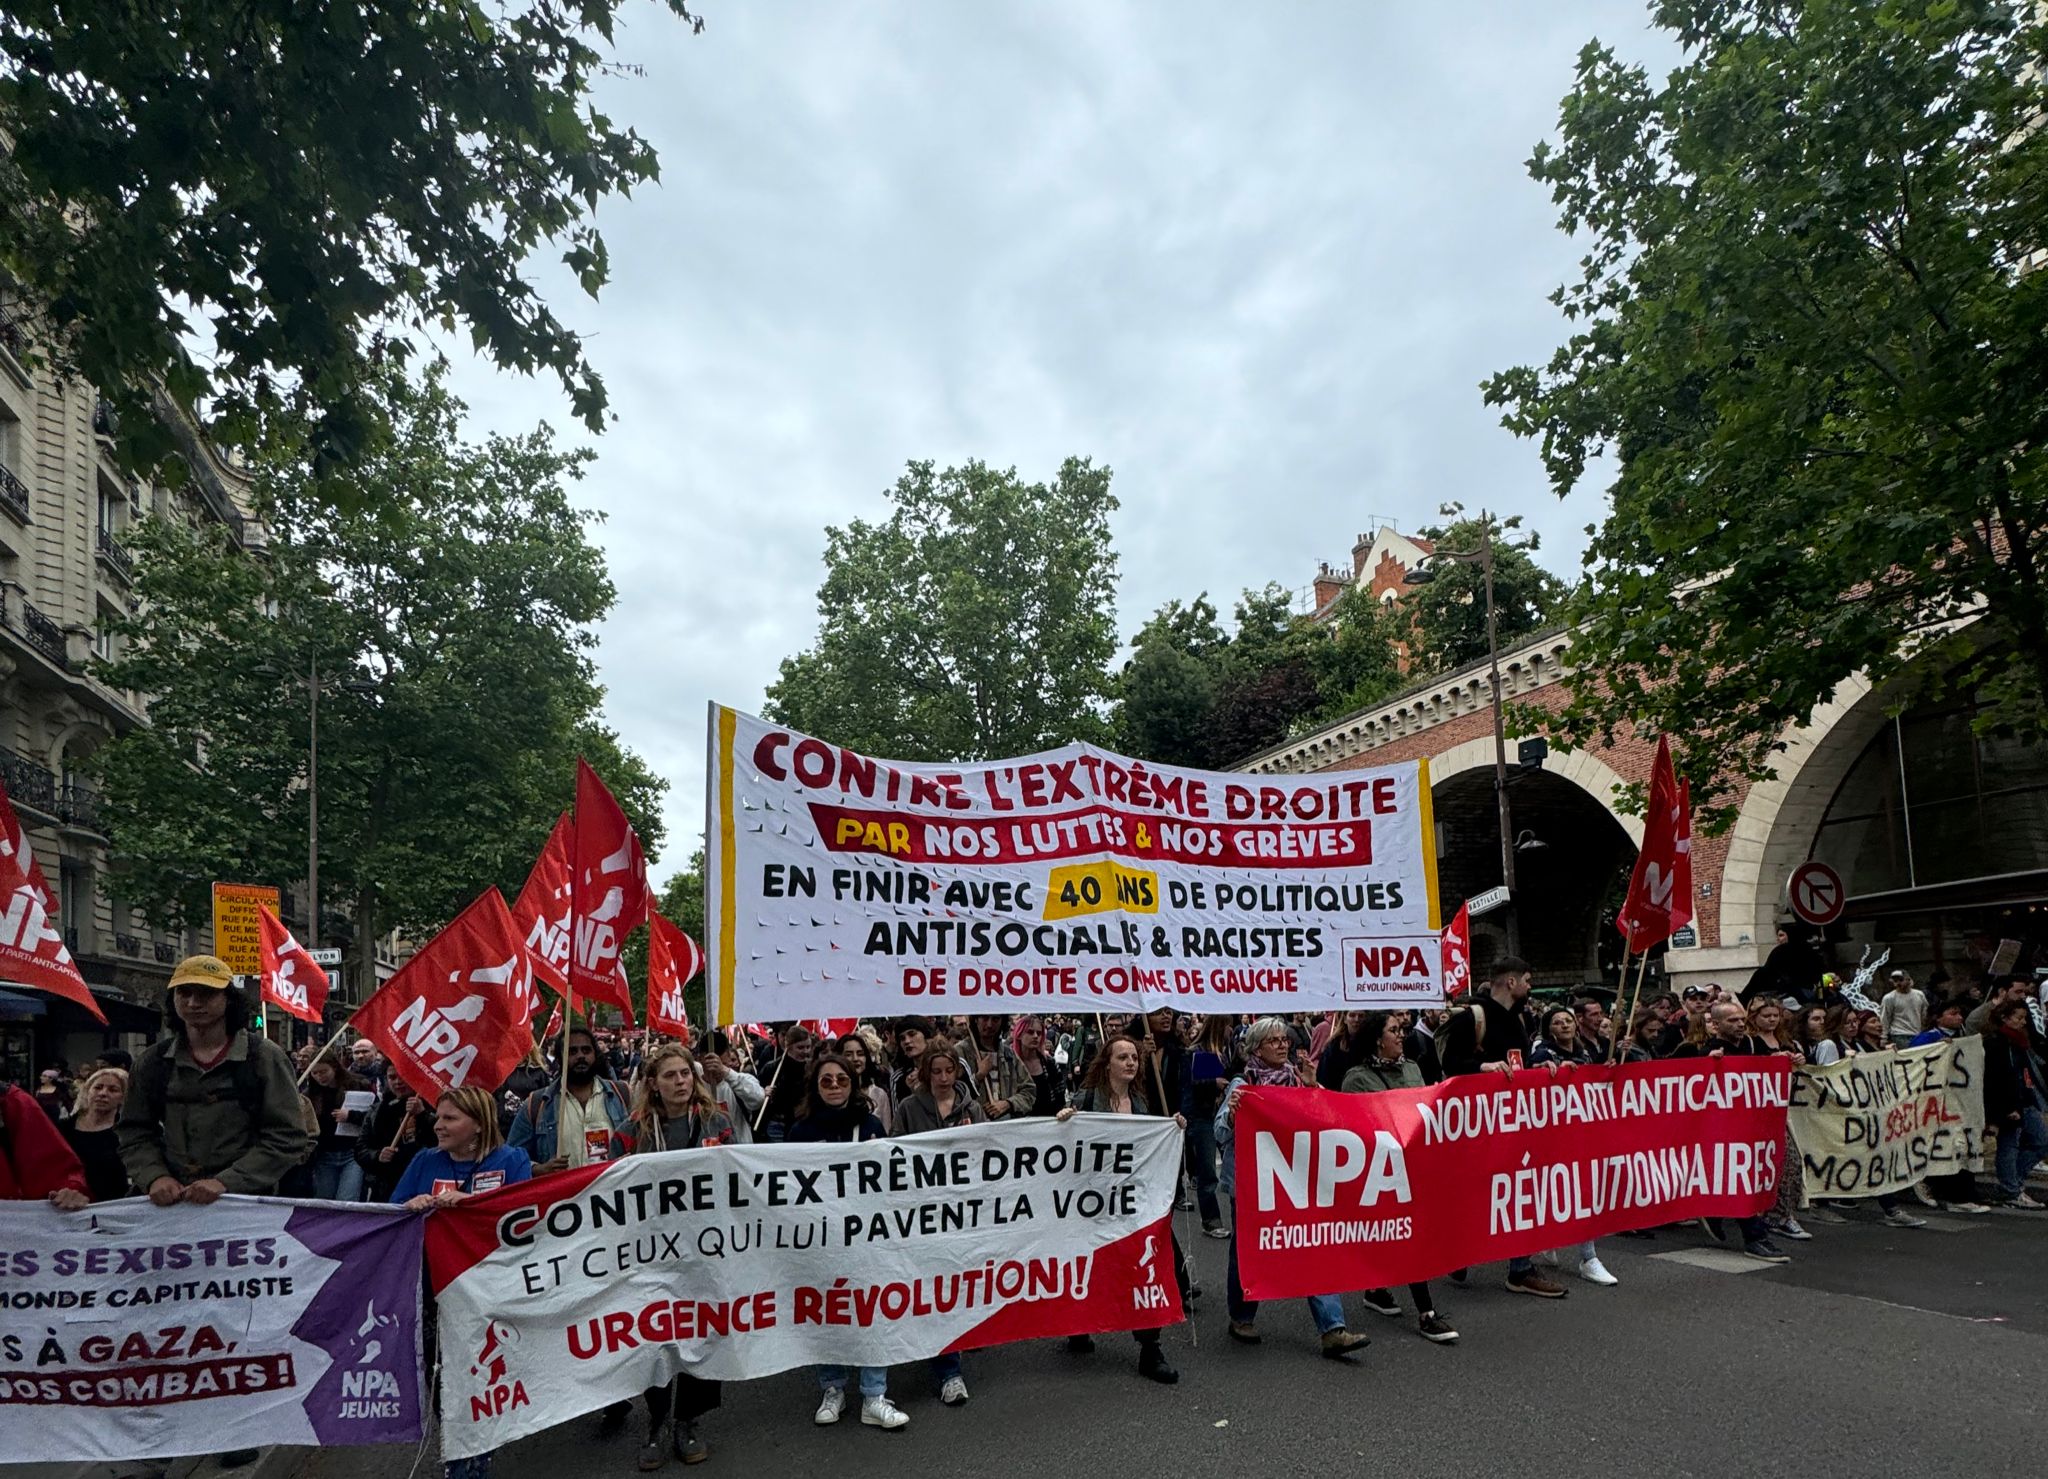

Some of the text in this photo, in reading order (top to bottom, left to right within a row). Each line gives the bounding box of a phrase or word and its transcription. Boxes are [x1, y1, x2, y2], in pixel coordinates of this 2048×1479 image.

[985, 754, 1209, 818] L'EXTRÊME
[1225, 778, 1398, 820] DROITE
[836, 816, 1356, 858] PAR NOS LUTTES & NOS GRÈVES
[219, 895, 279, 906] CIRCULATION
[763, 863, 817, 898] EN
[832, 869, 931, 905] FINIR
[943, 880, 1034, 912] AVEC
[1060, 875, 1102, 908] 40
[1168, 881, 1206, 910] DE
[1215, 881, 1405, 912] POLITIQUES
[1468, 891, 1500, 911] BASTILLE
[221, 914, 241, 924] RUE
[229, 905, 257, 914] DIFFIC
[223, 924, 241, 933] RUE
[1151, 926, 1172, 957] &
[1182, 928, 1323, 958] RACISTES
[228, 945, 247, 954] RUE
[1355, 946, 1430, 978] NPA
[271, 967, 309, 1010] NPA
[903, 968, 947, 995] DE
[959, 967, 1077, 997] DROITE
[1174, 969, 1205, 994] DE
[1210, 967, 1298, 994] GAUCHE
[1356, 981, 1432, 992] RÉVOLUTIONNAIRES
[392, 994, 479, 1089] NPA
[1416, 1086, 1549, 1146] NOUVEAU
[1551, 1081, 1618, 1127] PARTI
[1884, 1095, 1961, 1143] SOCIAL
[1844, 1115, 1880, 1150] DU
[1255, 1128, 1413, 1213] NPA
[1489, 1139, 1777, 1237] RÉVOLUTIONNAIRES
[499, 1139, 1134, 1247] CONTRE L'EXTRÊME DROITE
[521, 1184, 1138, 1295] ET CEUX QUI LUI PAVENT LA VOIE
[1258, 1216, 1413, 1251] RÉVOLUTIONNAIRES
[53, 1236, 289, 1277] SEXISTES,
[105, 1276, 294, 1308] CAPITALISTE
[1133, 1284, 1170, 1311] NPA
[567, 1290, 778, 1361] URGENCE
[36, 1326, 67, 1367] À
[79, 1324, 238, 1364] GAZA,
[341, 1370, 401, 1399] NPA
[470, 1379, 531, 1423] NPA
[338, 1400, 401, 1420] JEUNES
